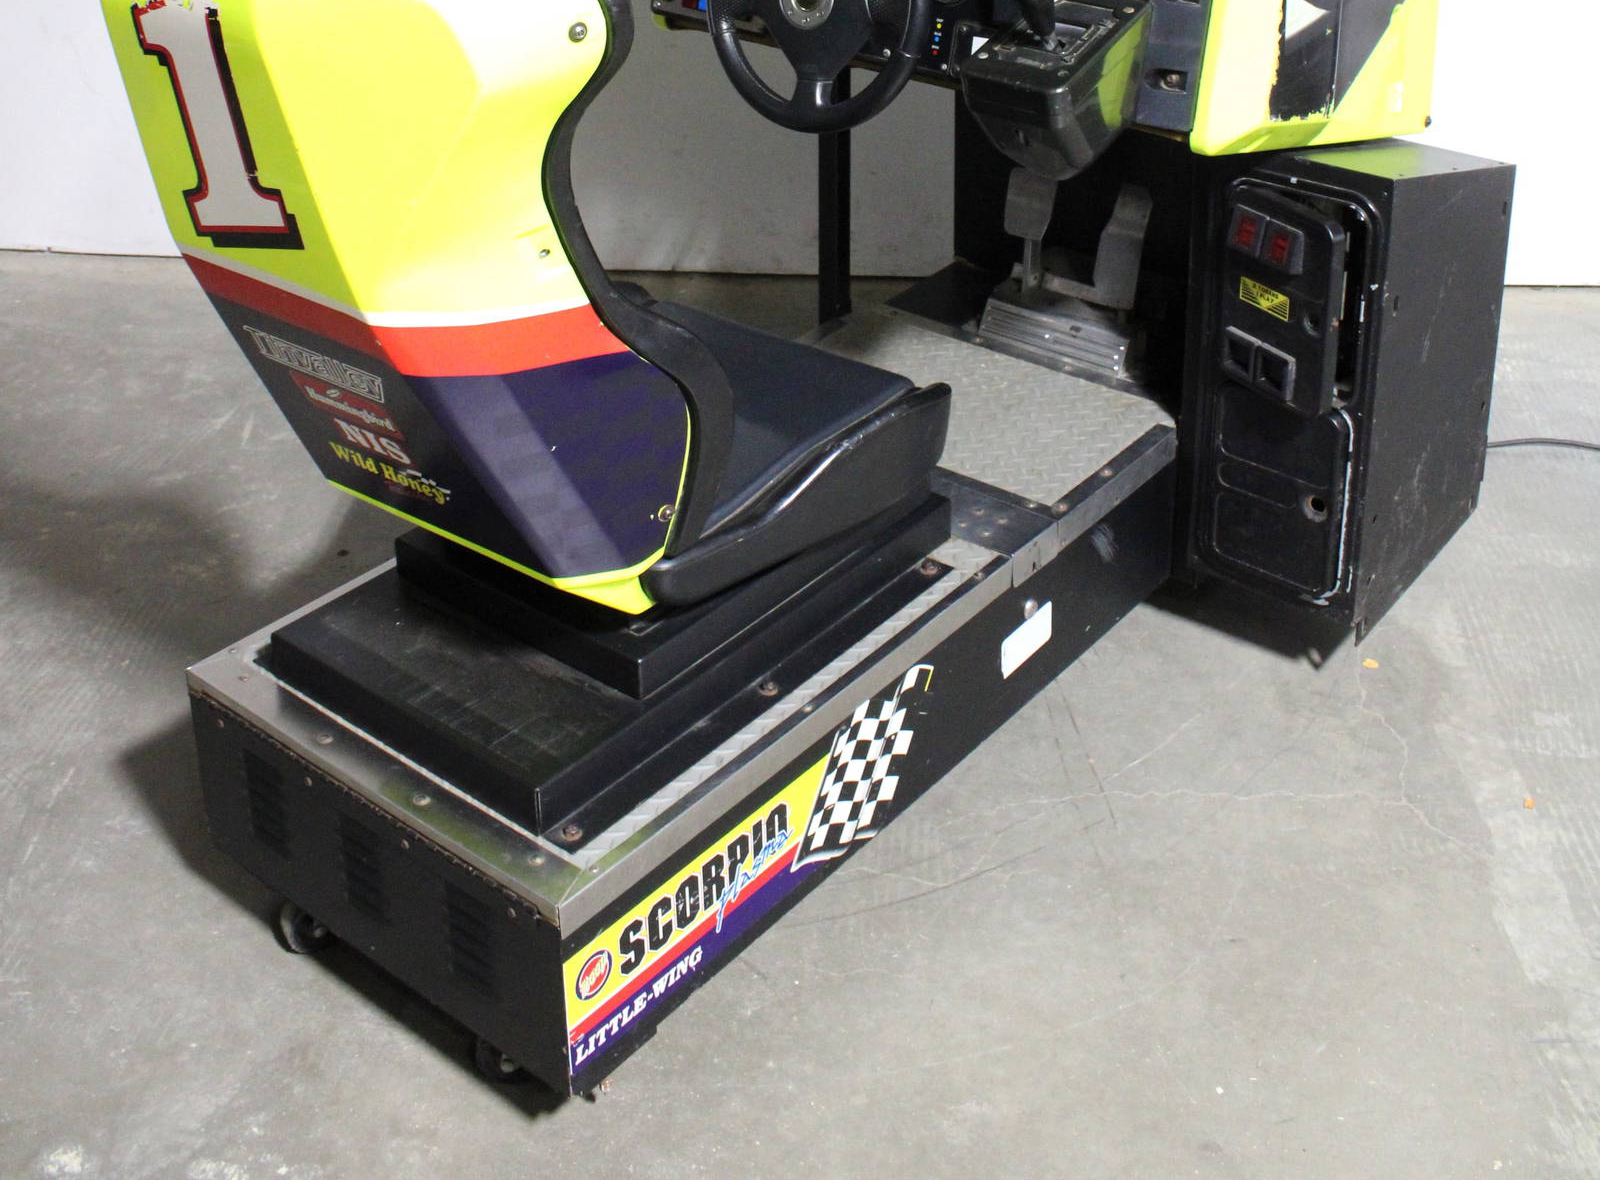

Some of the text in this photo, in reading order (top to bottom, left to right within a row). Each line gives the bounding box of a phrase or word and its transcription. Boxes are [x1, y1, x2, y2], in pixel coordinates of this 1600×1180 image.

[243, 325, 384, 404] Tinvalley
[329, 441, 446, 505] Wild Honey
[334, 418, 411, 465] NIS
[619, 802, 788, 976] SCORPIO
[575, 945, 703, 1066] LITTLE-WING
